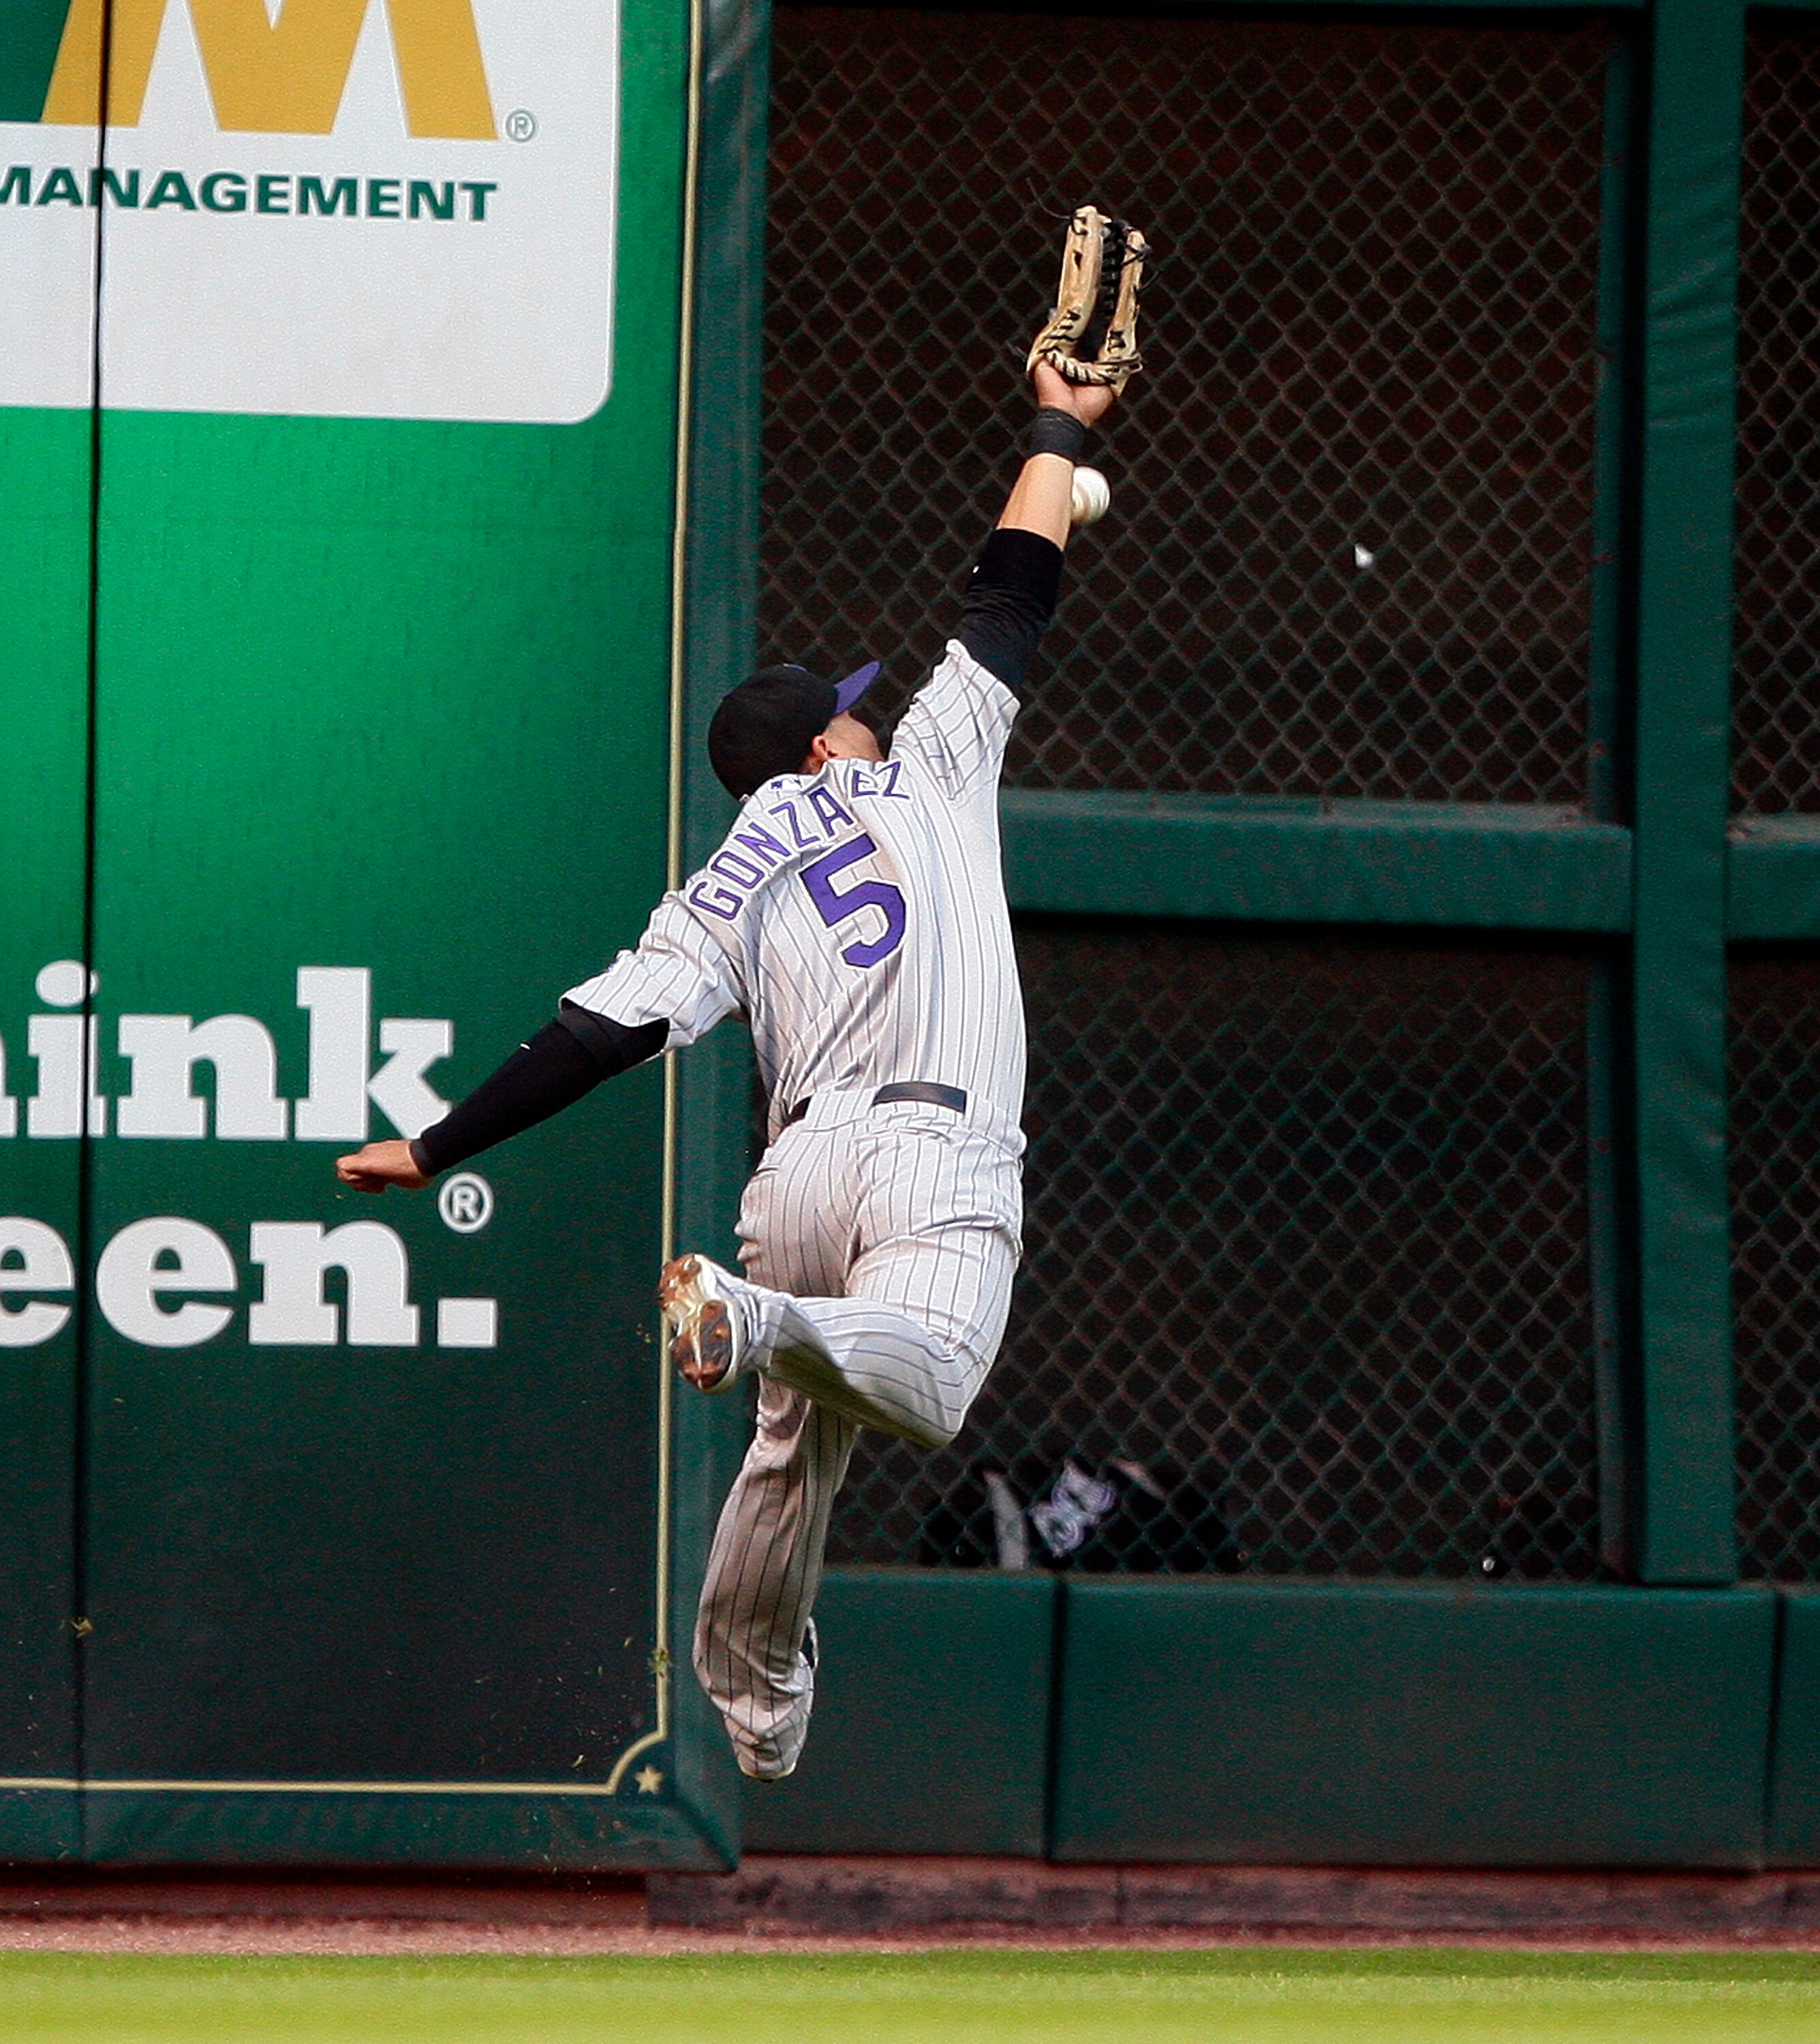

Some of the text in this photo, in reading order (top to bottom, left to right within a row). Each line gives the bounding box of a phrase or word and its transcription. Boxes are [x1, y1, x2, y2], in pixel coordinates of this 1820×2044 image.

[688, 760, 911, 922] GONZAEZ
[797, 831, 908, 969] 5
[0, 960, 453, 1140] ink
